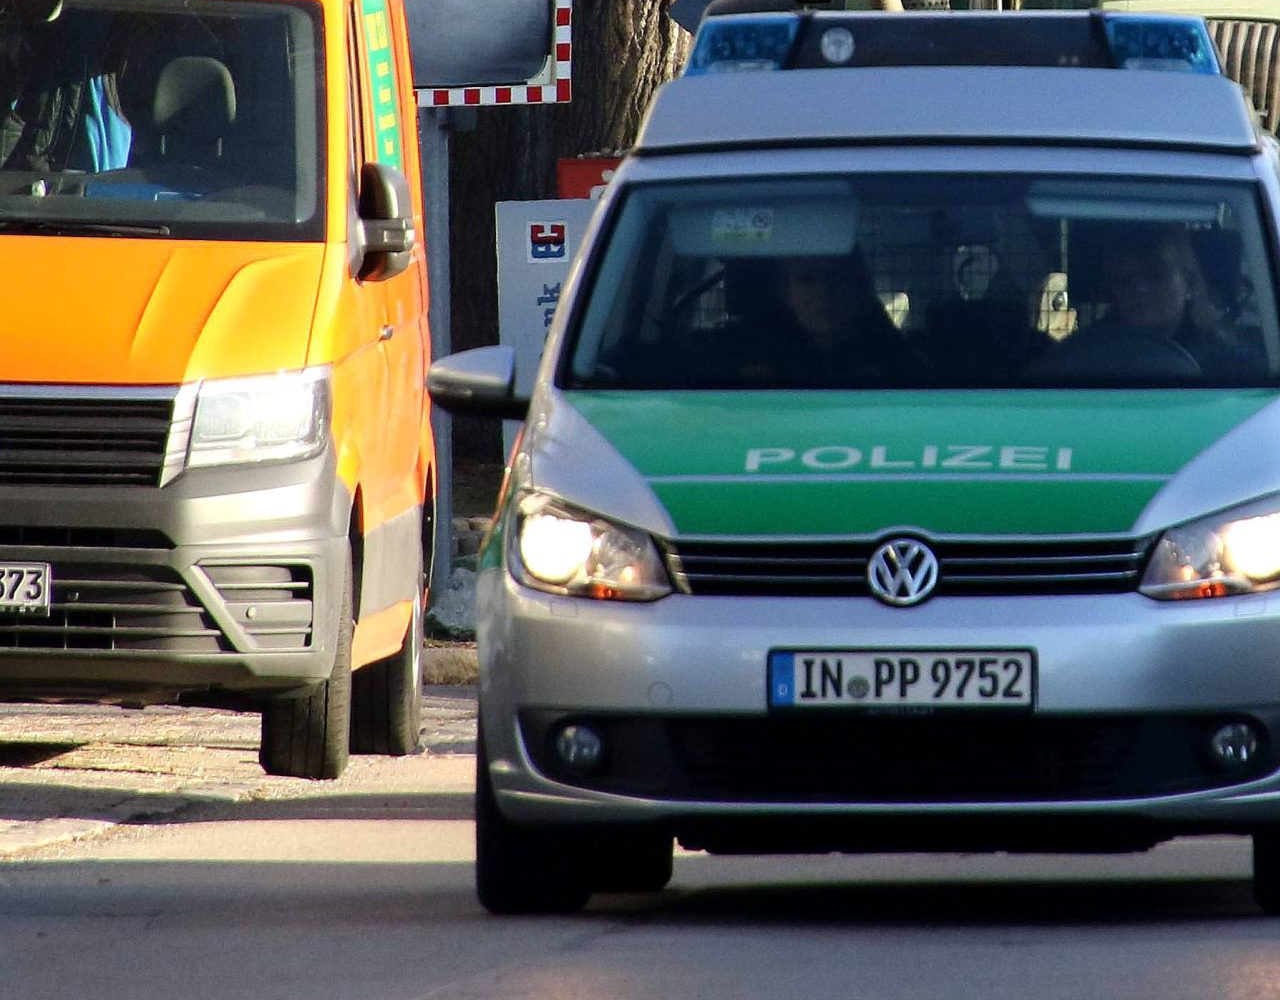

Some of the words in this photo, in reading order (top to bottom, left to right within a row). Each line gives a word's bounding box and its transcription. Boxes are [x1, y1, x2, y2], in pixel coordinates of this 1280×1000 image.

[745, 445, 1073, 473] POLIZEI
[800, 658, 843, 699] IN
[874, 658, 920, 699] PP
[931, 658, 1023, 699] 9752
